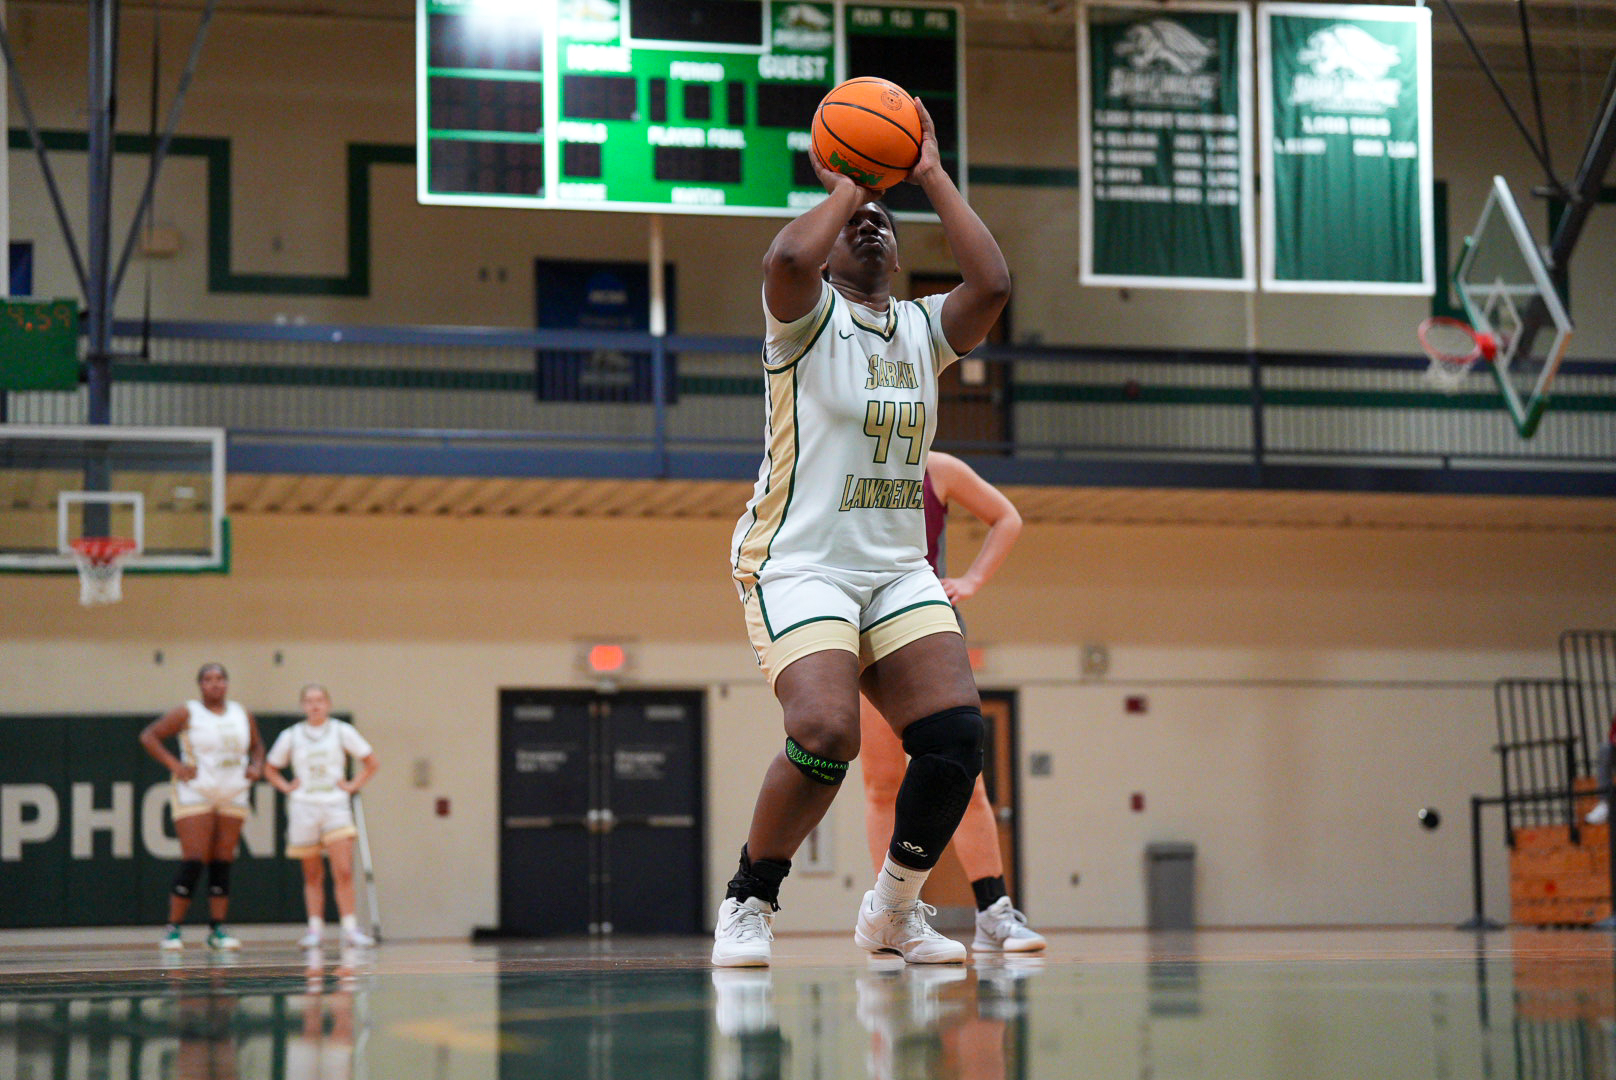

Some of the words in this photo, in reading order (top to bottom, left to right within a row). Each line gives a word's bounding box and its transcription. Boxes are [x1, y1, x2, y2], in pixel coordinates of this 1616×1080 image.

[758, 55, 827, 80] GUEST
[865, 354, 918, 389] SARAH
[863, 400, 926, 465] 44
[839, 474, 925, 511] LAWRENC
